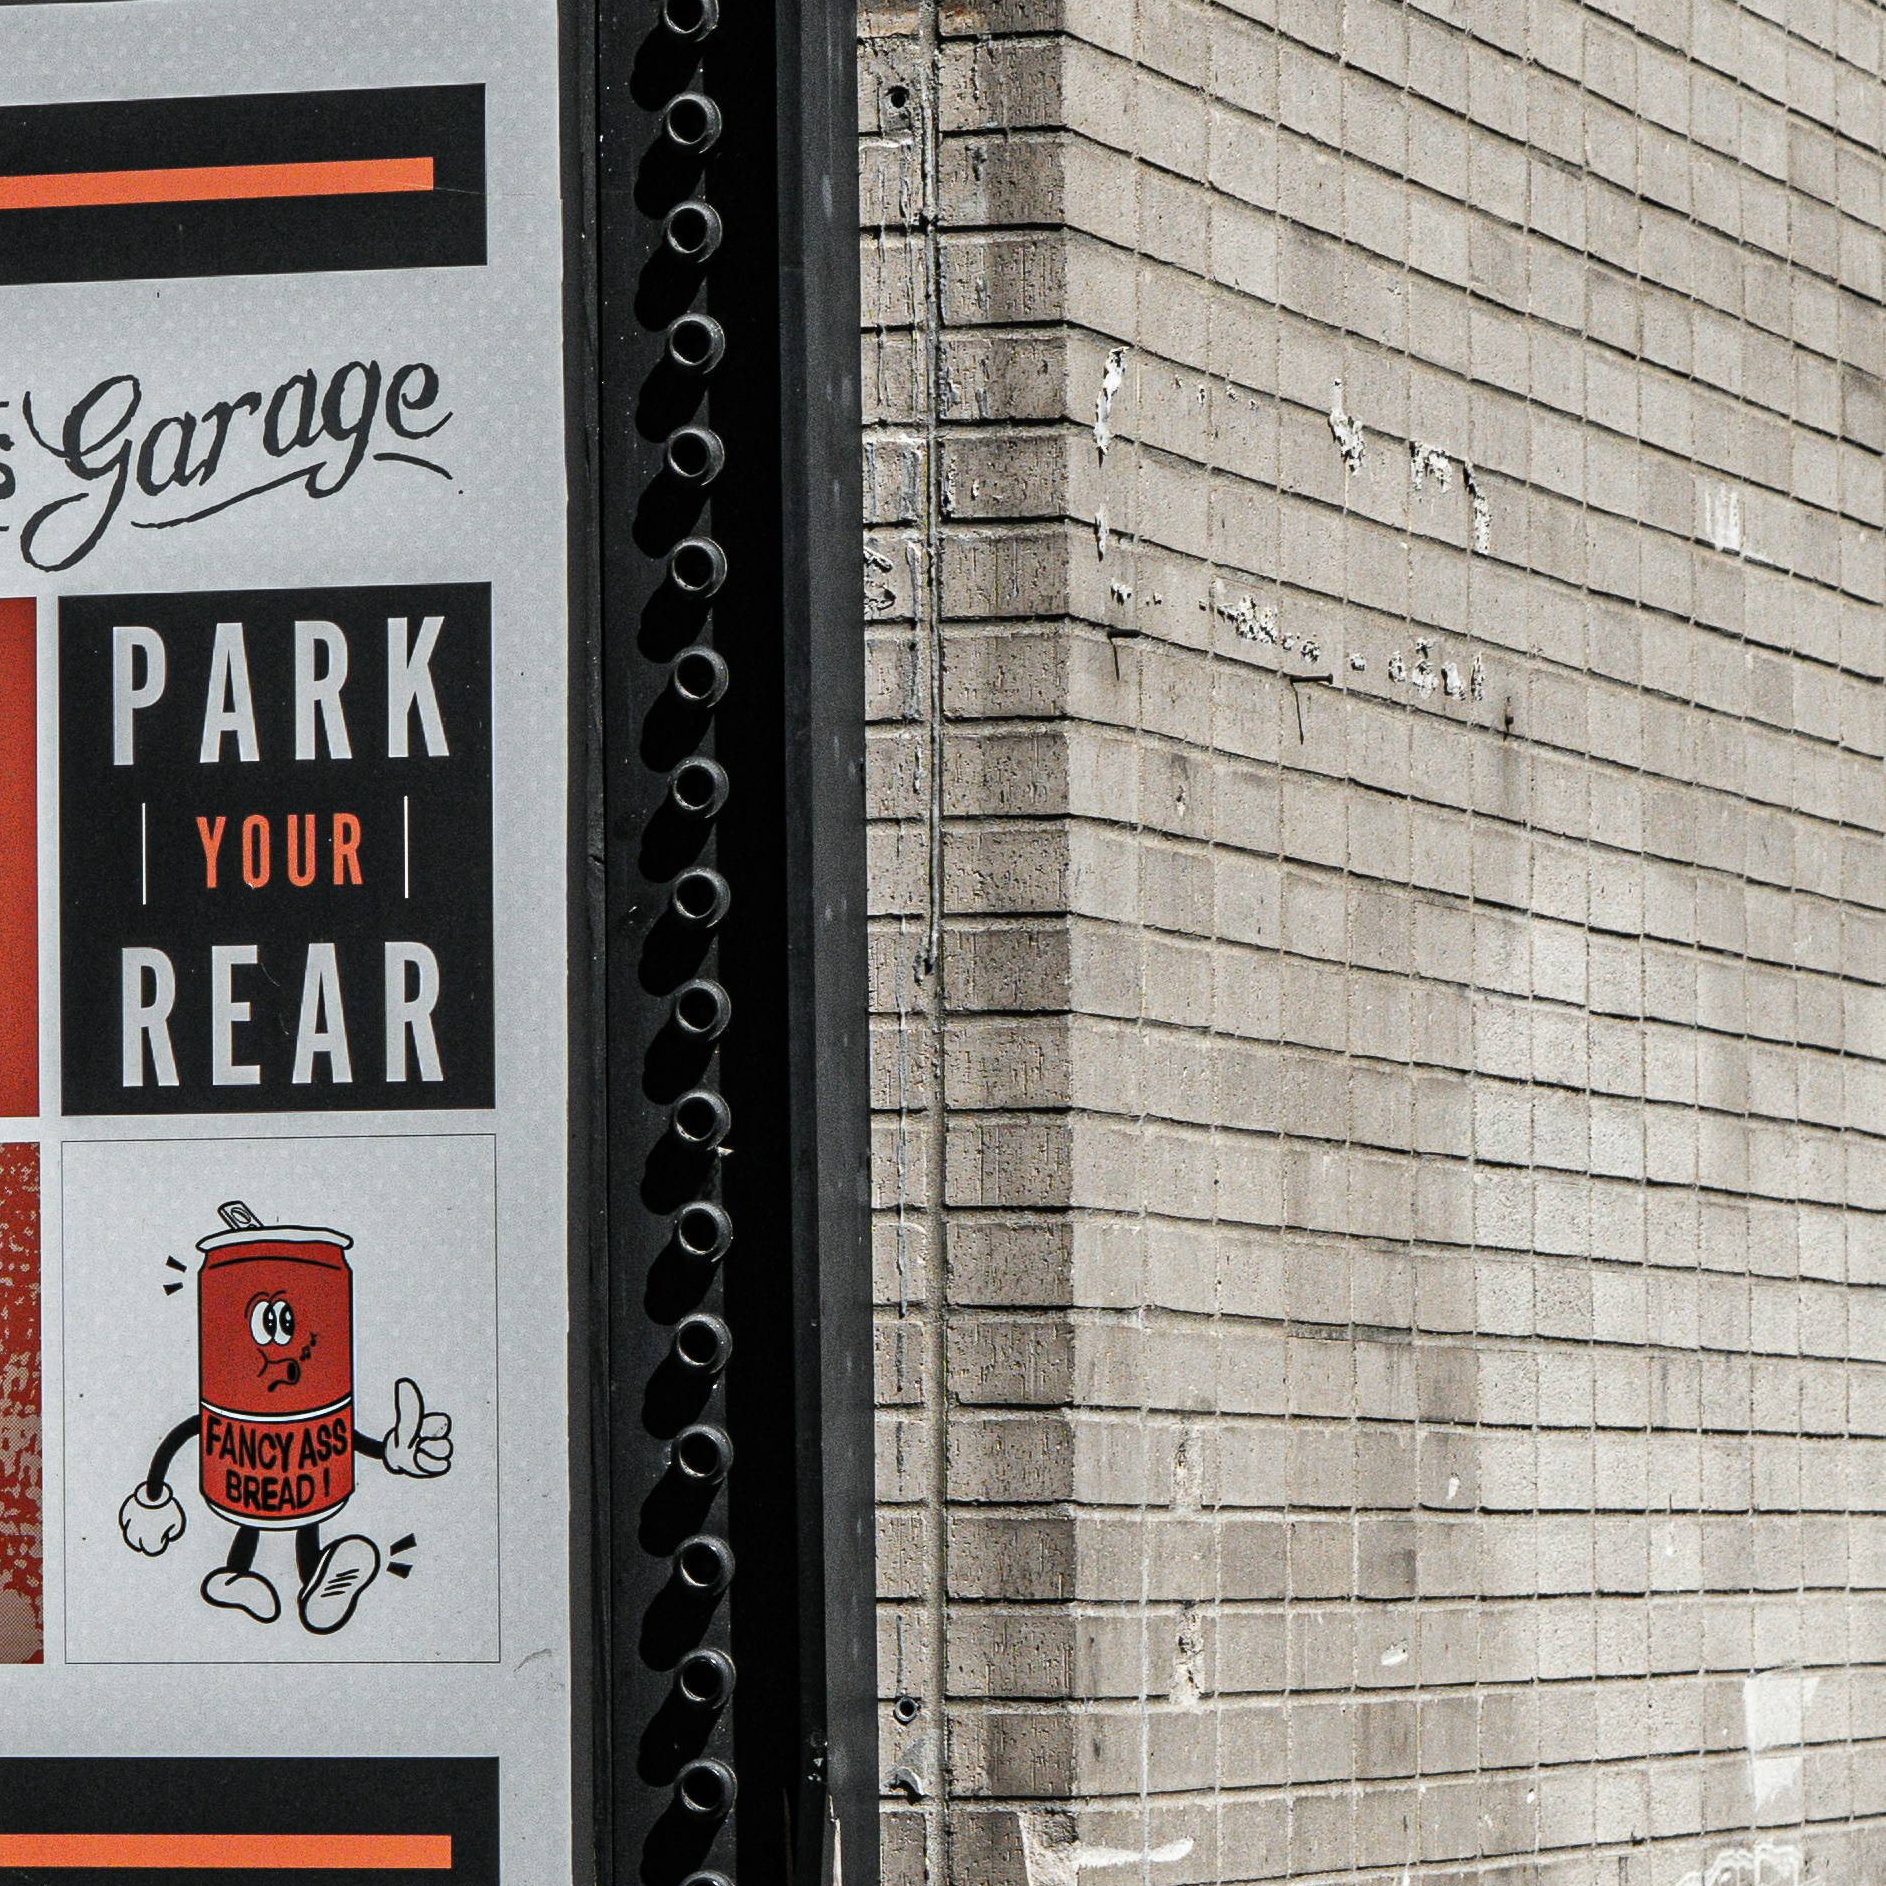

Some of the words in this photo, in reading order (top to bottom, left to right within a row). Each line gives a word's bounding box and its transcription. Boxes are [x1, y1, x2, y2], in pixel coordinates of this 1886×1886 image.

[19, 359, 455, 572] Garage
[113, 615, 451, 766] PARK
[195, 812, 364, 889] YOUR
[121, 940, 444, 1088] REAR
[205, 1414, 295, 1473] FANCY
[298, 1417, 349, 1470] ASS
